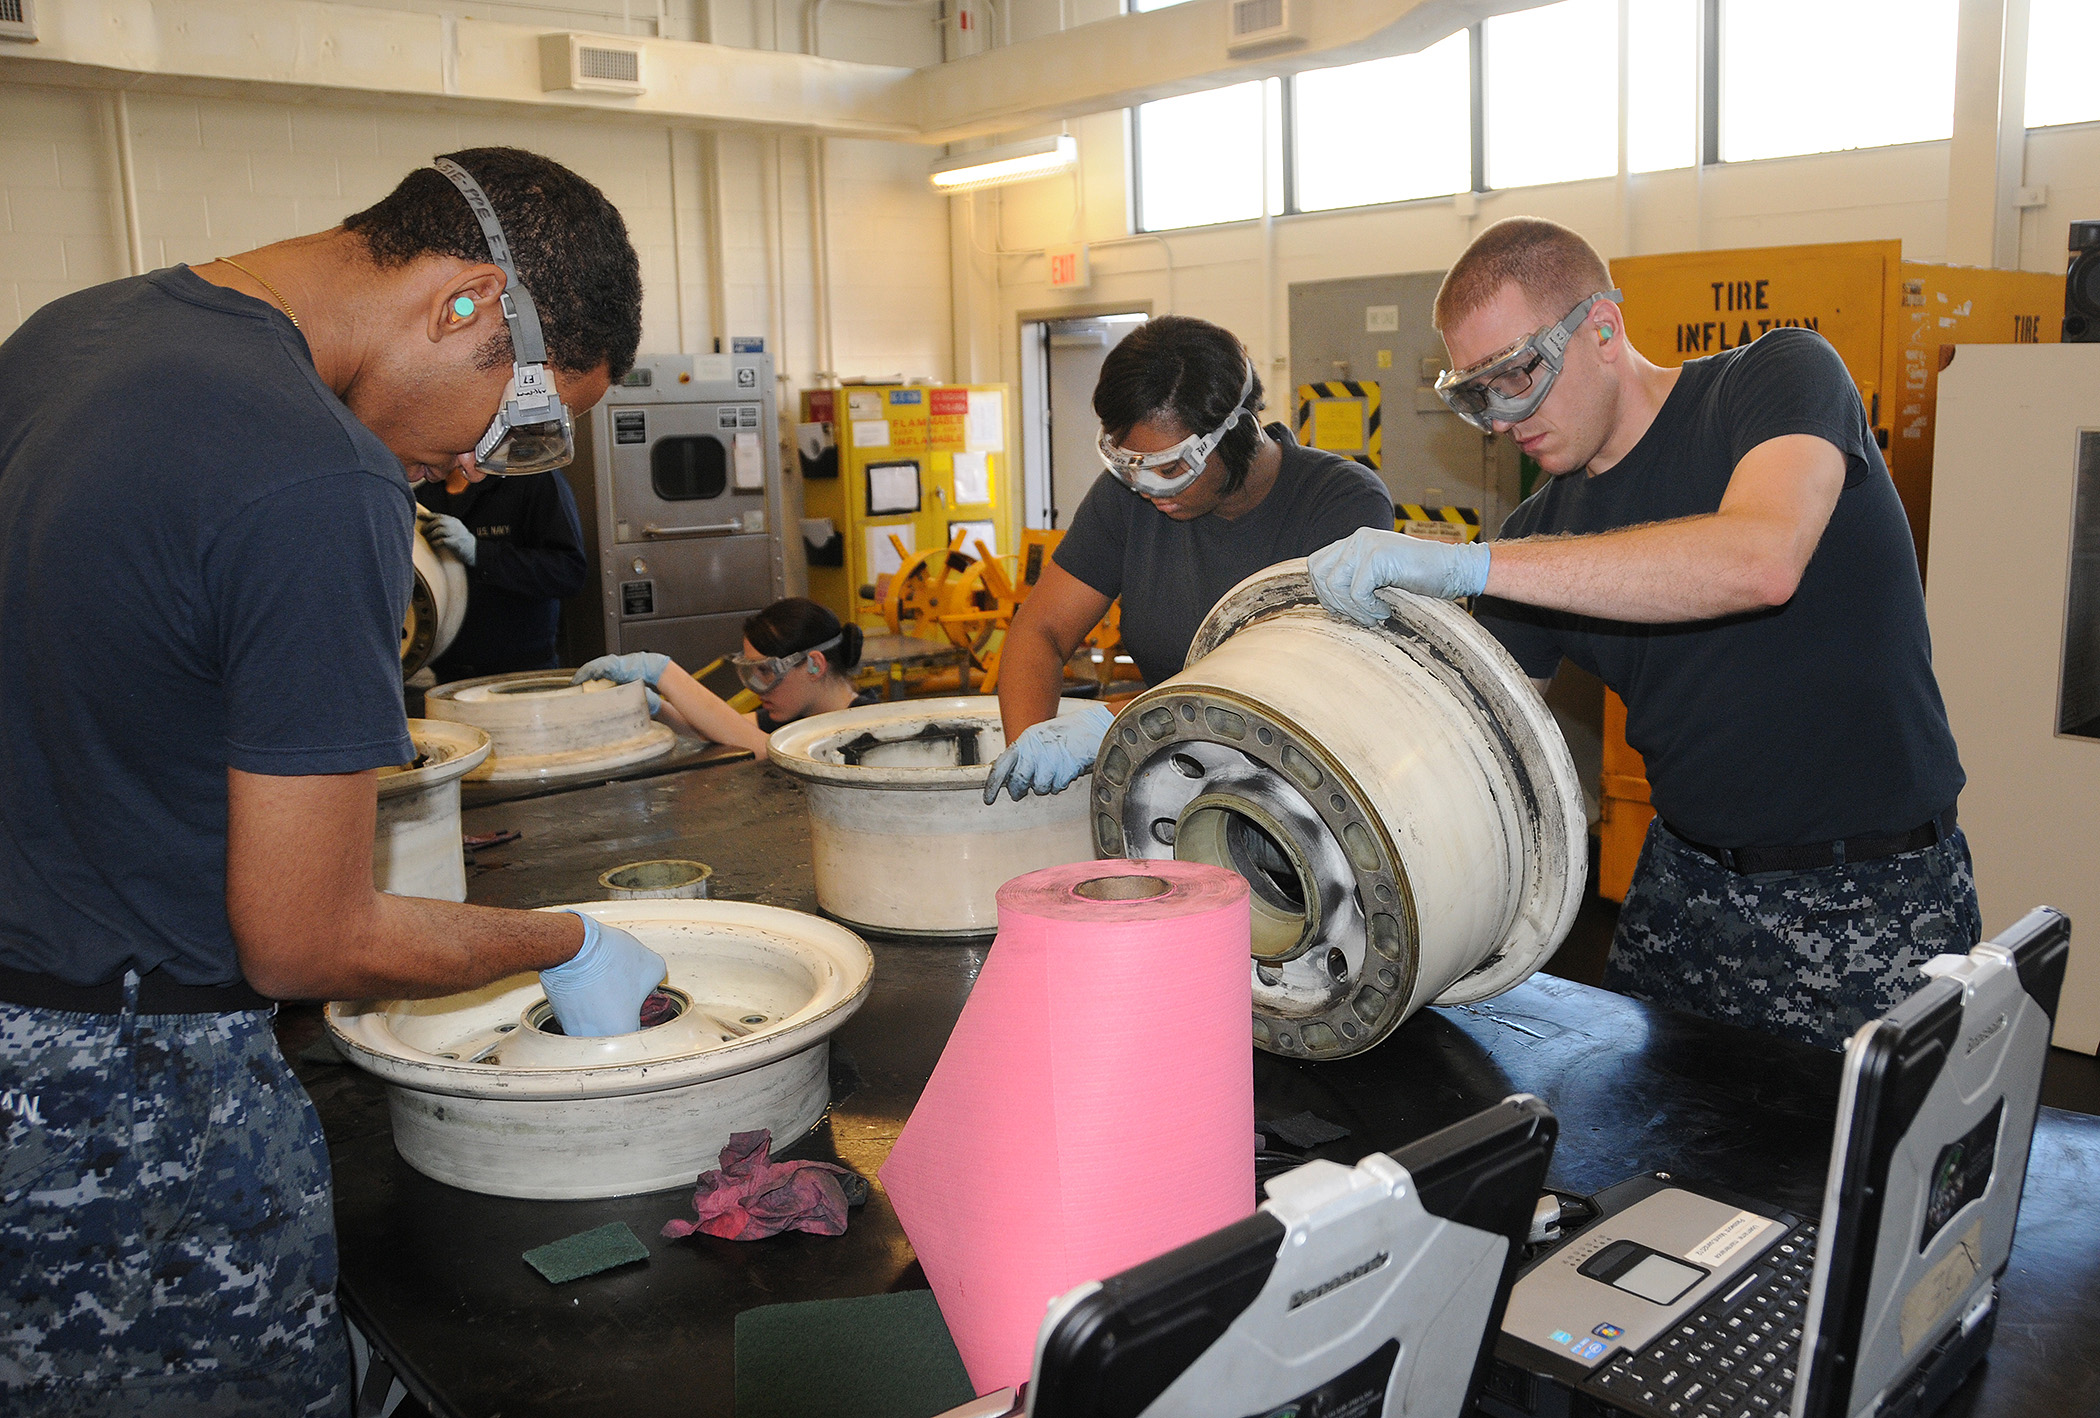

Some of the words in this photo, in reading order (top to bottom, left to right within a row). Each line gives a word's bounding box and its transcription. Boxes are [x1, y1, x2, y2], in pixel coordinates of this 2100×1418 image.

[1051, 253, 1075, 284] EXIT
[1711, 280, 1769, 311] TIRE
[2014, 315, 2040, 343] TIRE
[490, 525, 511, 536] NAVY
